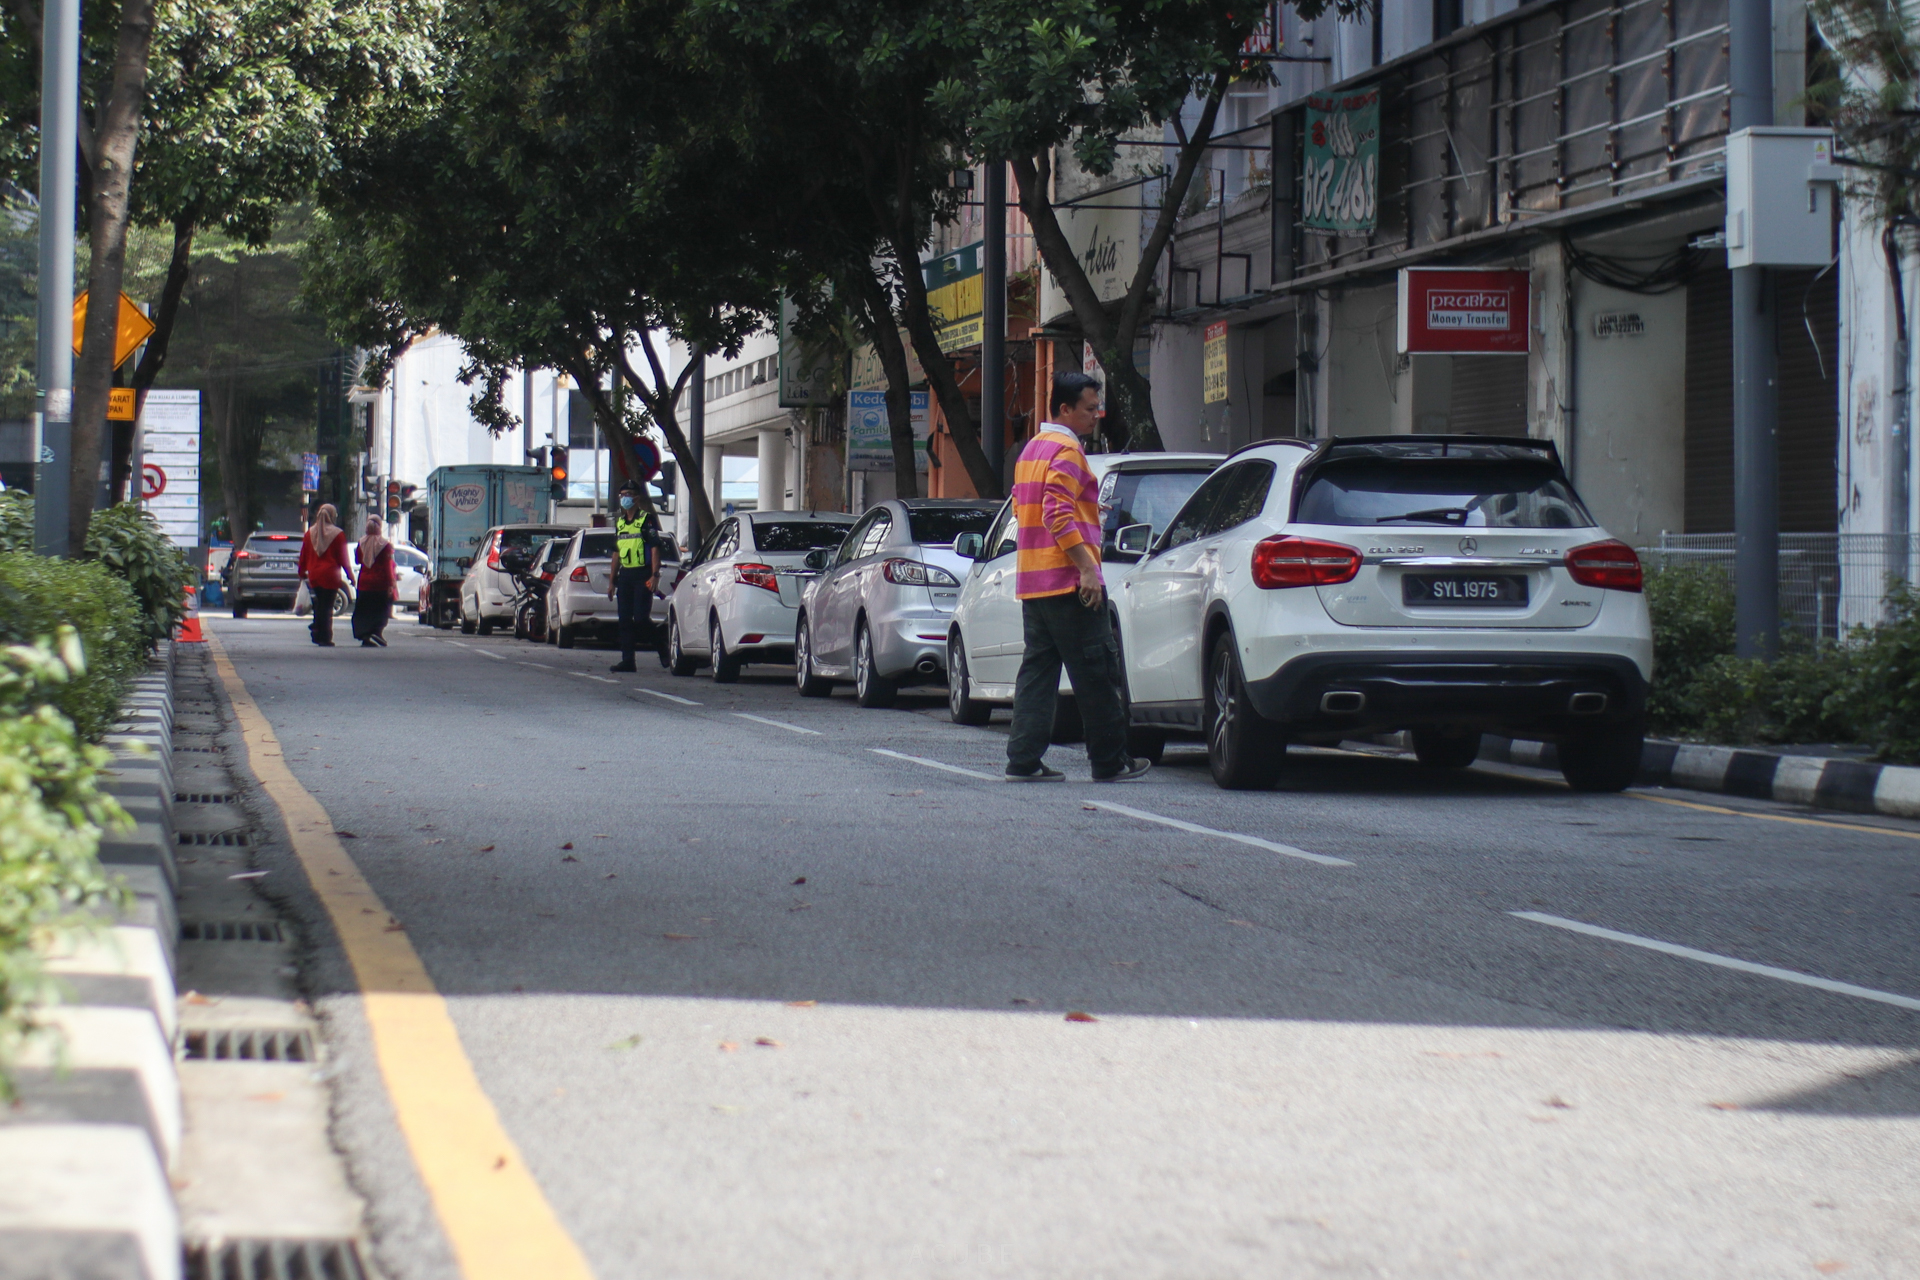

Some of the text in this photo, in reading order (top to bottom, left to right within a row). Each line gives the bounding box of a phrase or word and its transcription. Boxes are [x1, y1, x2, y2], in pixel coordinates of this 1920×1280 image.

[1084, 224, 1118, 276] Asia
[1431, 313, 1506, 326] Money Transfer
[1214, 324, 1224, 336] Rent
[109, 395, 131, 404] YARAT
[854, 394, 887, 405] Ked
[108, 405, 124, 414] PAN
[853, 424, 889, 436] Family
[451, 487, 480, 499] Mighty
[455, 498, 479, 507] White
[1368, 546, 1396, 554] GLA
